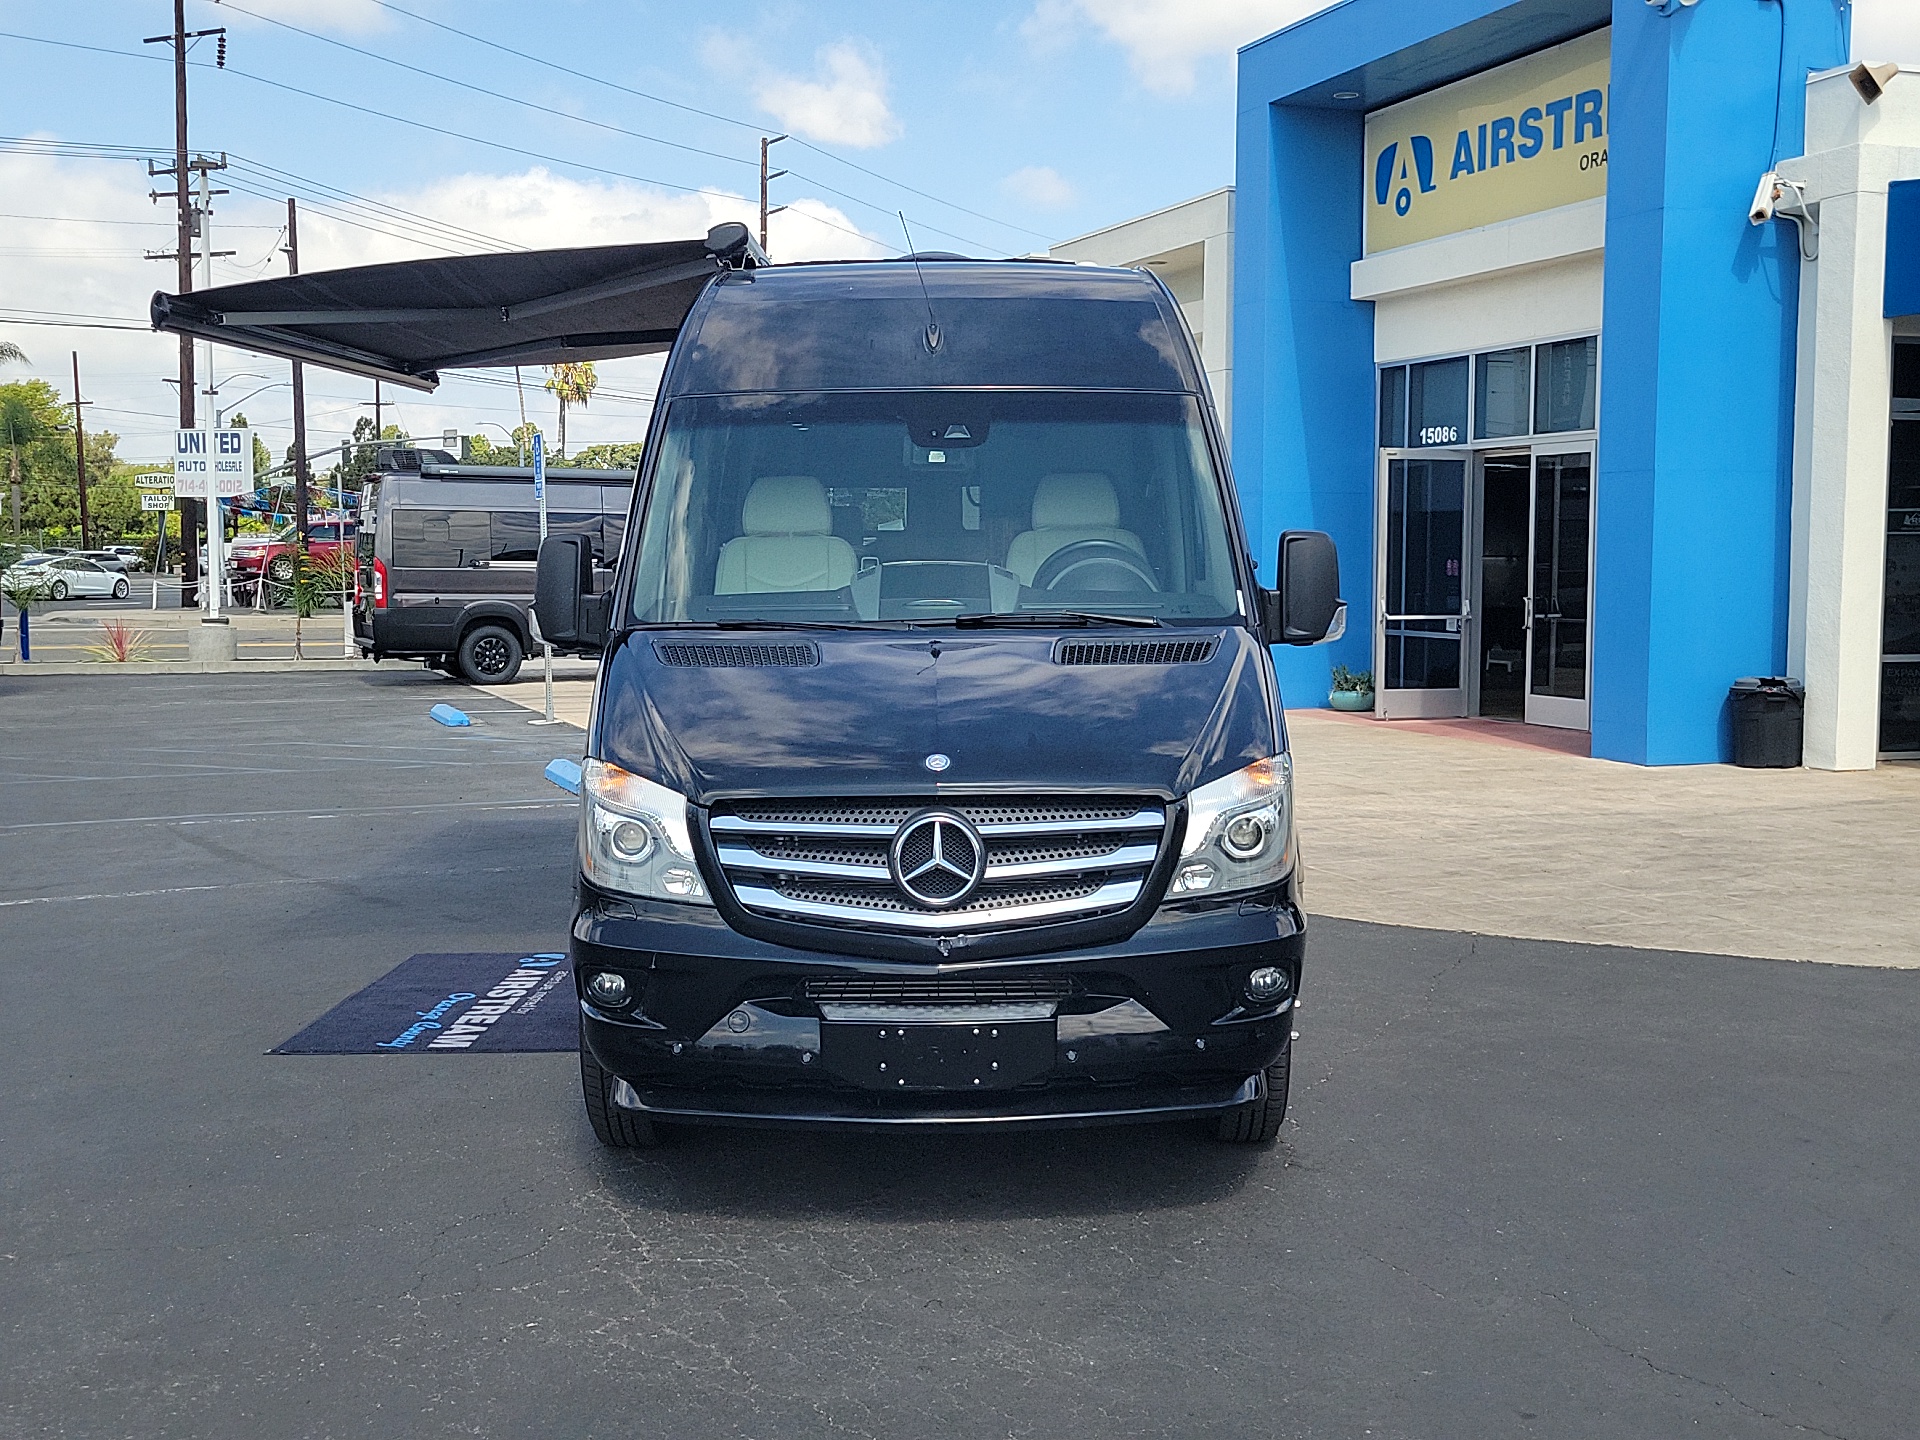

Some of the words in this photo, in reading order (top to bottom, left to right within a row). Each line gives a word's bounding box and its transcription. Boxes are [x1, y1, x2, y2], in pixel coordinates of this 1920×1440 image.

[1450, 83, 1611, 180] AIRSTR
[1419, 426, 1458, 444] 15086
[136, 476, 175, 484] ALTERATIO
[178, 461, 207, 472] AUTO
[416, 992, 477, 1020] Orange
[427, 968, 549, 1048] AIRSTREAM
[376, 1021, 442, 1048] County
